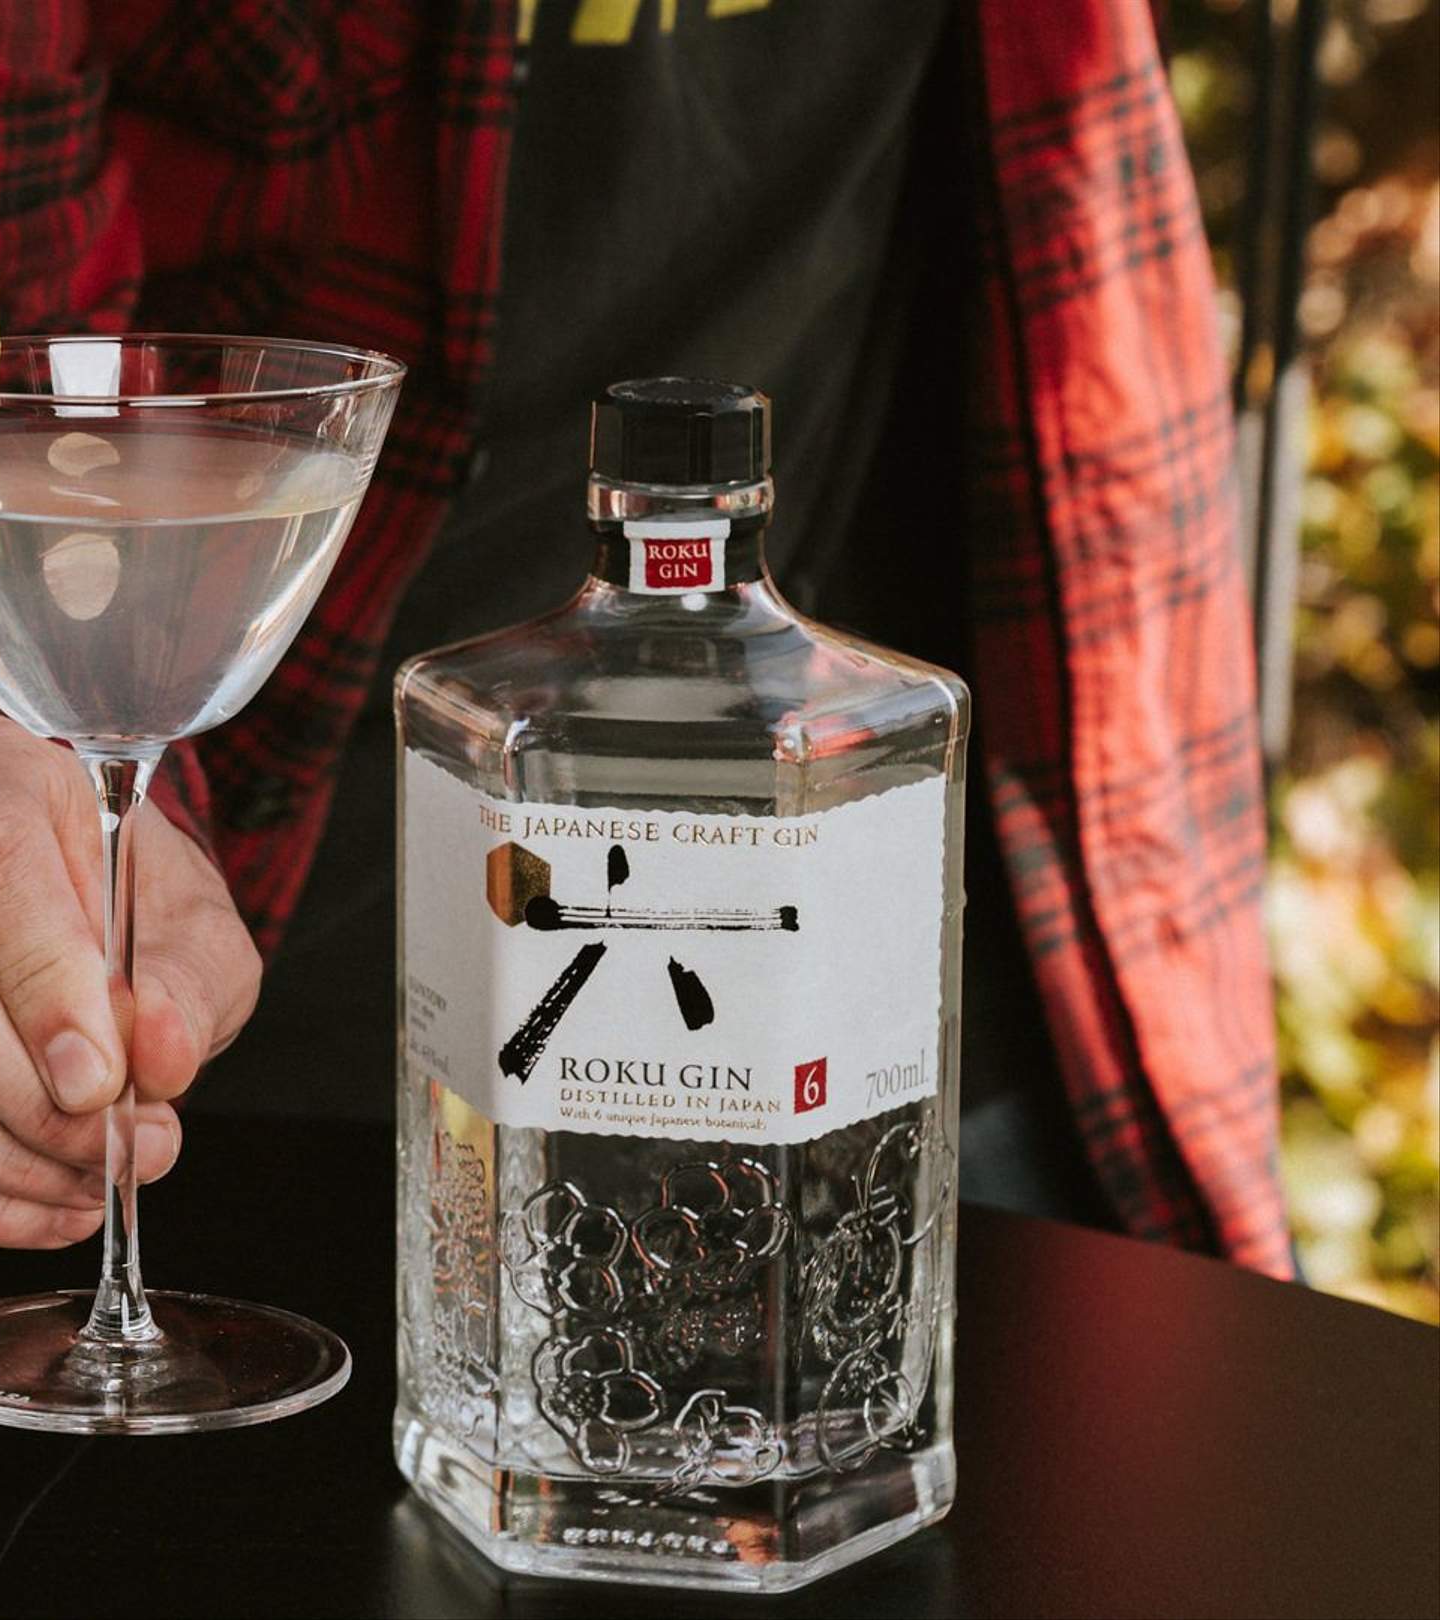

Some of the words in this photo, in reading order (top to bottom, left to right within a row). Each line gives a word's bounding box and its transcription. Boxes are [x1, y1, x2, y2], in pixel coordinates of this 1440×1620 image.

[648, 543, 708, 560] ROKU
[659, 563, 698, 579] GIN
[479, 805, 512, 832] THE
[522, 816, 660, 841] JAPANESE
[672, 823, 765, 847] CRAFT
[774, 823, 819, 847] GIN
[560, 1056, 666, 1087] ROKU
[679, 1064, 753, 1092] GIN
[802, 1065, 820, 1105] 6
[560, 1087, 676, 1108] DISTILLED
[686, 1095, 710, 1109] IN
[719, 1098, 782, 1114] JAPAN
[560, 1105, 591, 1120] With
[593, 1108, 602, 1121] 6
[606, 1111, 647, 1127] unique
[649, 1113, 701, 1128] Japanese
